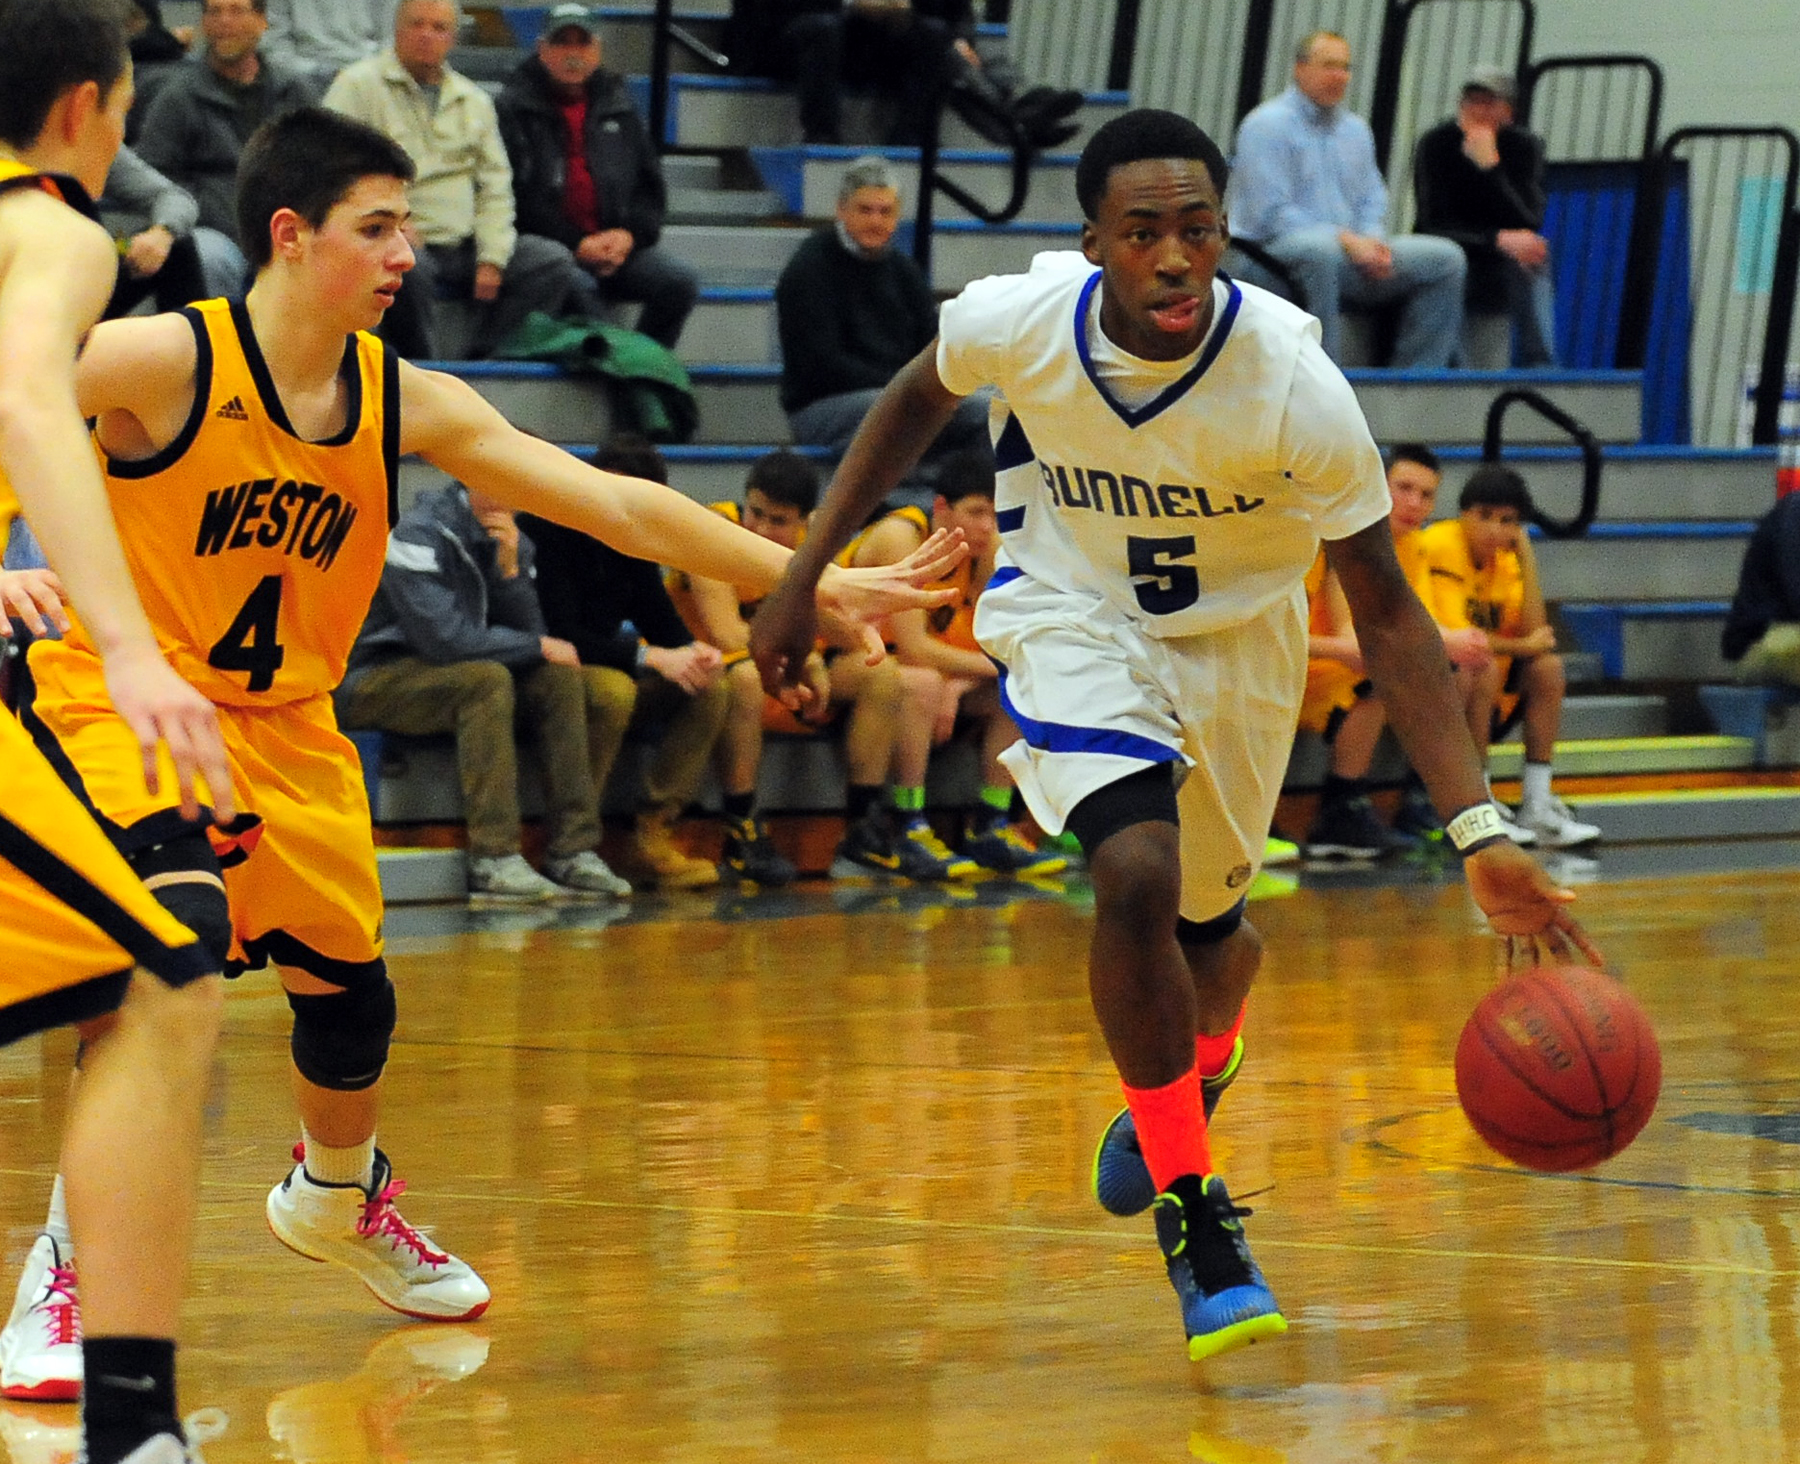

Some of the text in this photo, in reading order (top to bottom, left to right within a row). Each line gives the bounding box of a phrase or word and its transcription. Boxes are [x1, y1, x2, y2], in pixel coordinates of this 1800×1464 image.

[194, 477, 359, 573] WESTON
[1126, 535, 1200, 616] 5
[207, 574, 285, 693] 4
